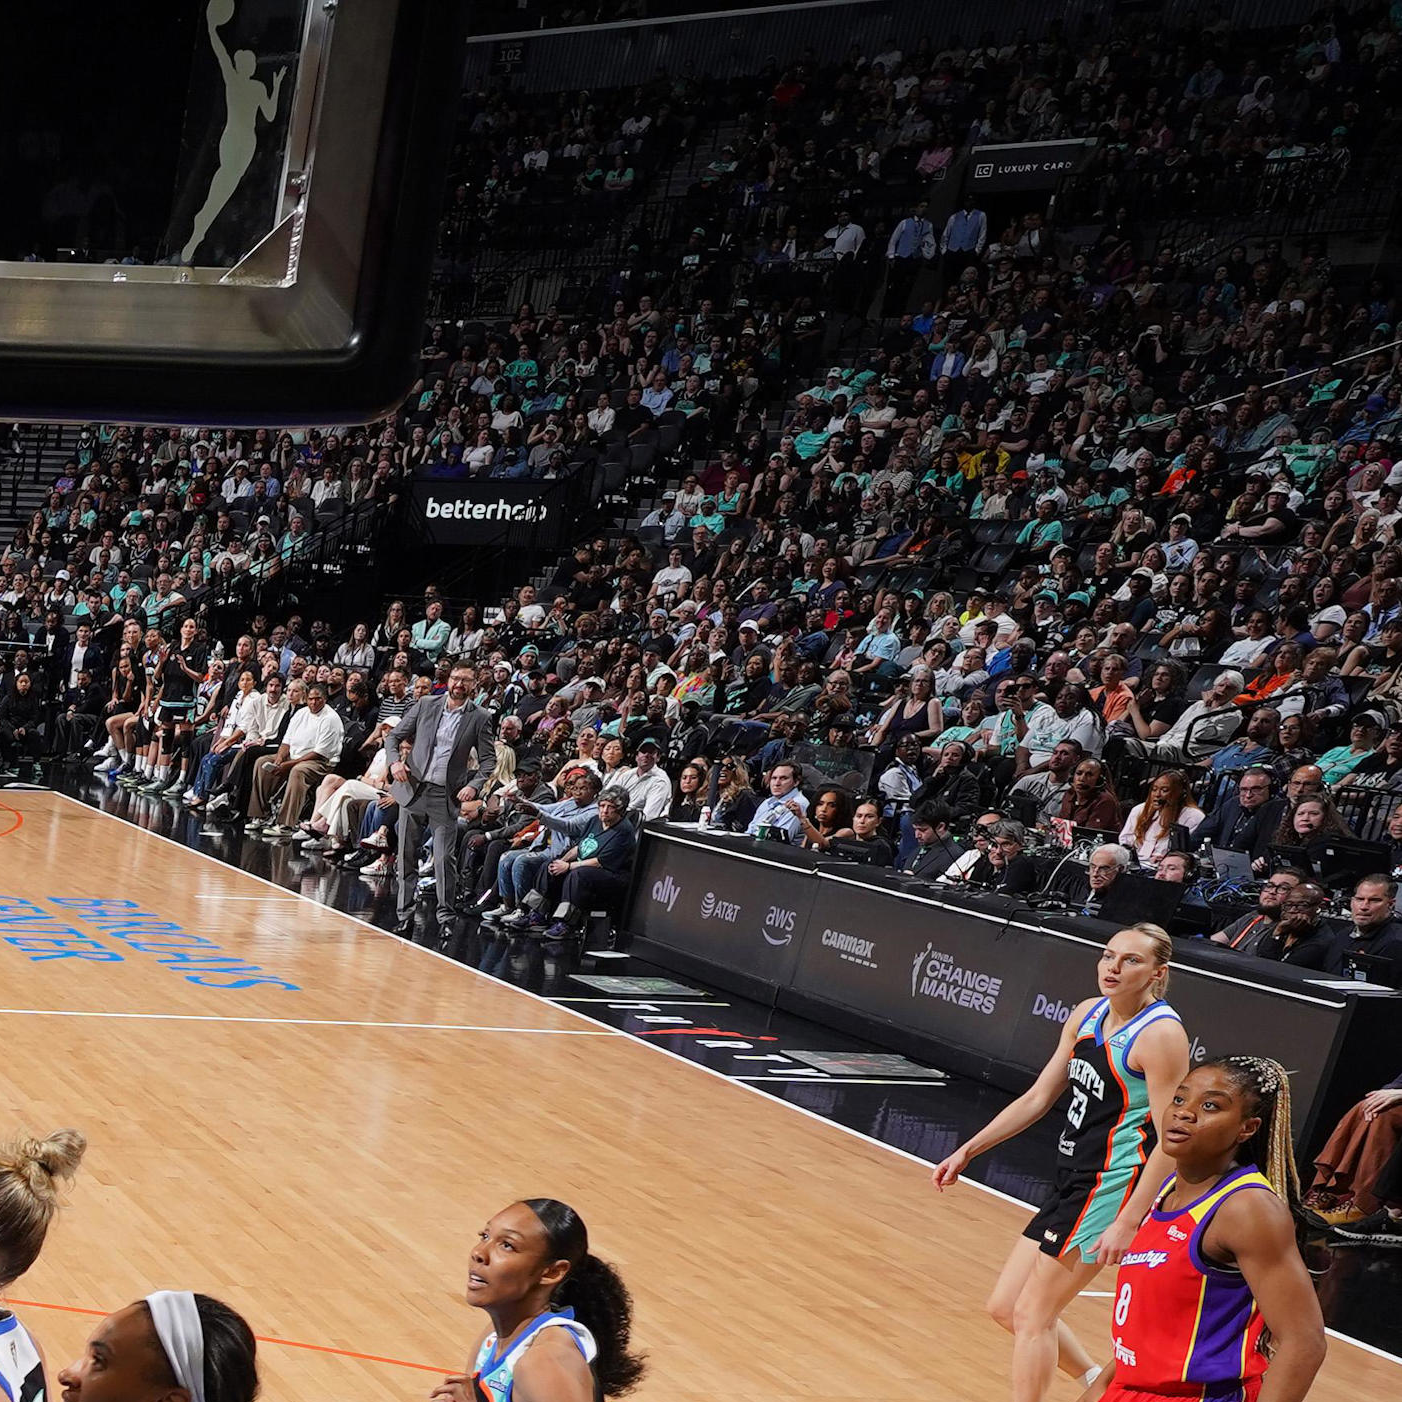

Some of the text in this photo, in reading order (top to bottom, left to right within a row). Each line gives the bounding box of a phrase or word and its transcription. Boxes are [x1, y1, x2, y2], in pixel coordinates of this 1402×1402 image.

[998, 163, 1039, 174] LUXURY
[1042, 161, 1073, 171] CARD
[651, 875, 682, 912] ally
[713, 899, 742, 923] AT&T
[765, 905, 797, 932] aws
[931, 950, 955, 965] WNBA
[919, 976, 997, 1016] MAKERS
[925, 962, 1003, 997] CHANGE
[1066, 1085, 1088, 1130] 23
[1115, 1282, 1132, 1327] 8
